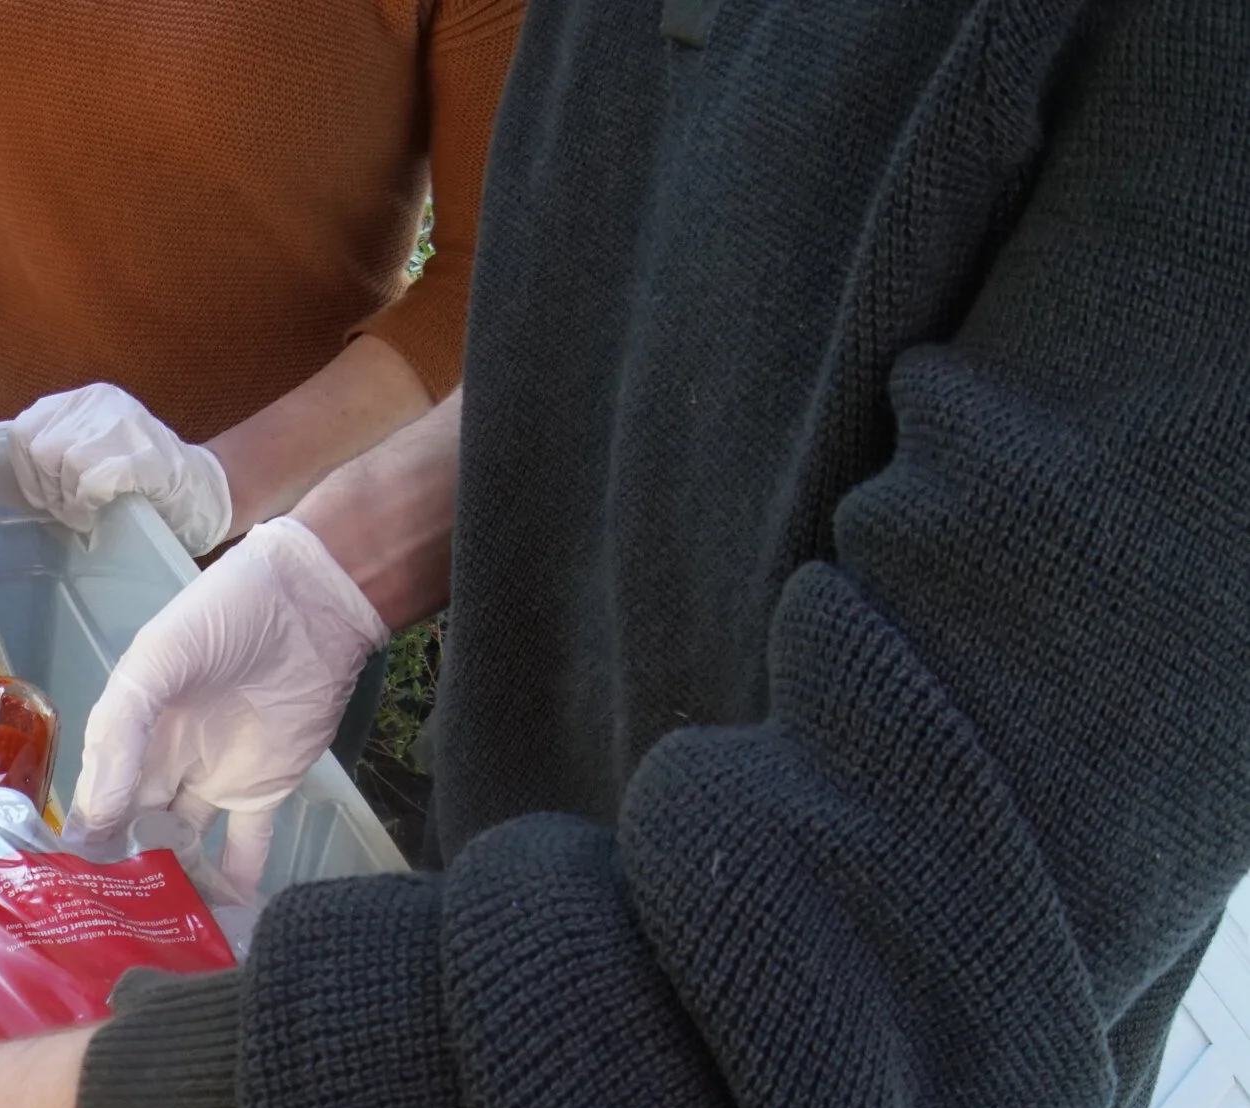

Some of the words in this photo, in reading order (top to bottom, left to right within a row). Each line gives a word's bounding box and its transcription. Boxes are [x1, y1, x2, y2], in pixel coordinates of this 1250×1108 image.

[59, 911, 78, 922] kids
[70, 918, 117, 930] Jumpstart
[80, 930, 105, 940] water
[107, 929, 132, 938] every
[56, 934, 77, 945] pack
